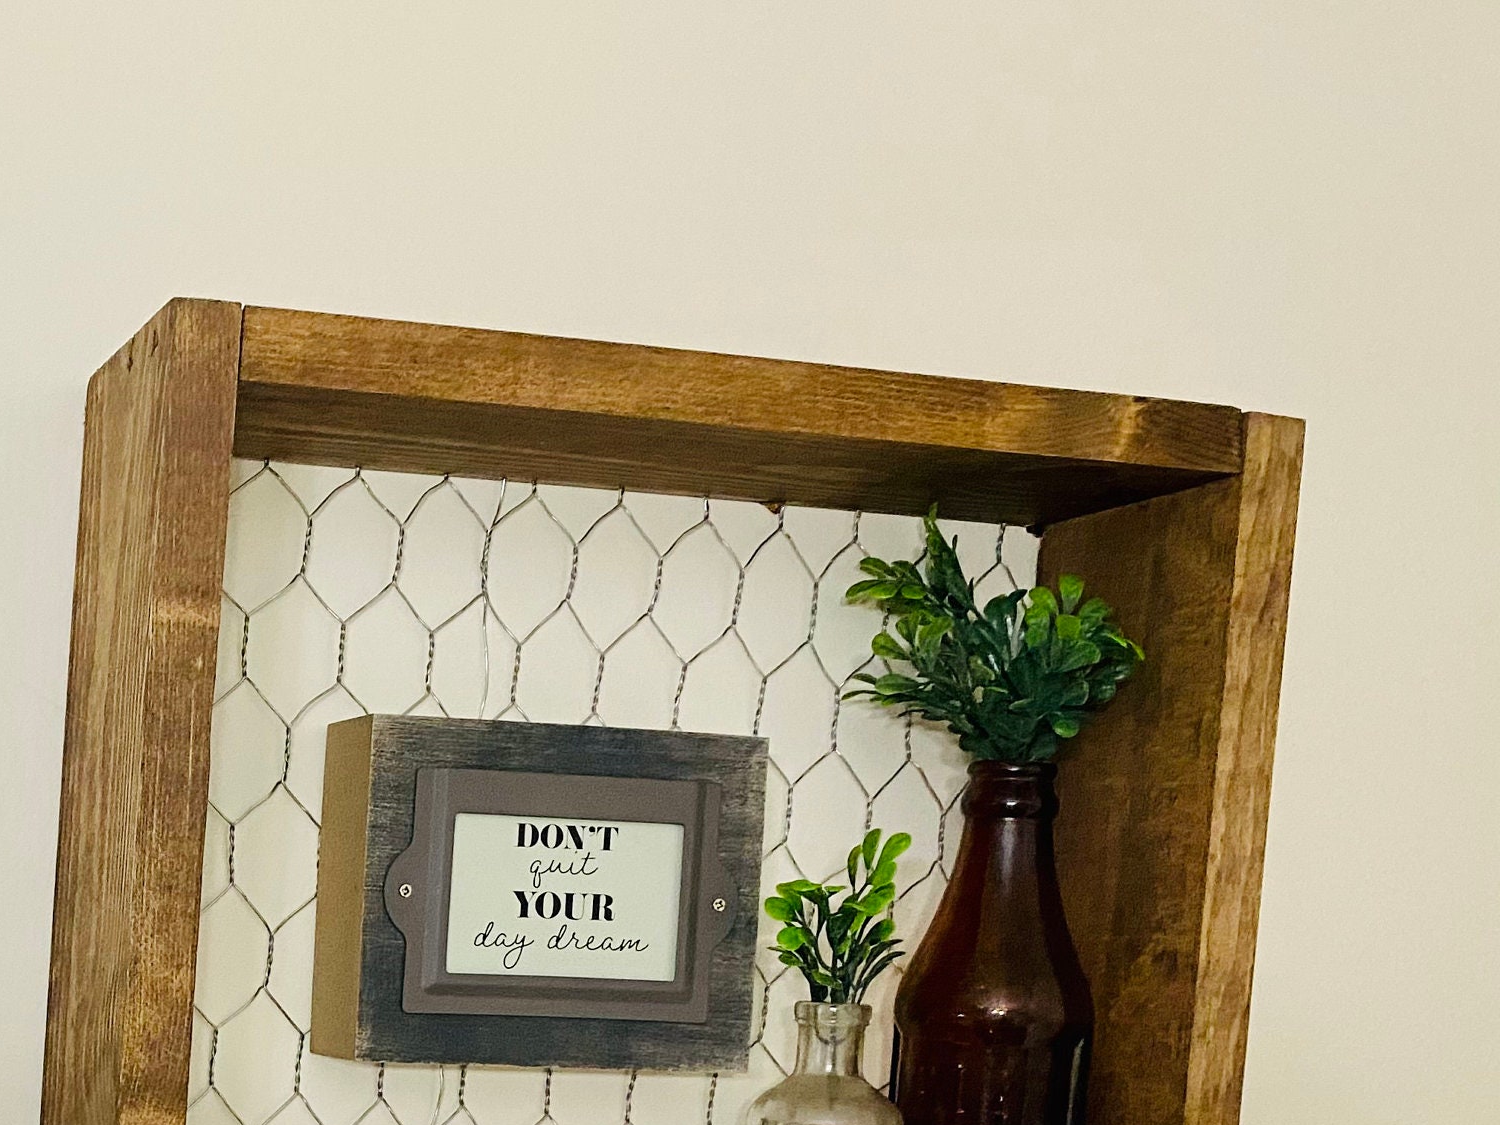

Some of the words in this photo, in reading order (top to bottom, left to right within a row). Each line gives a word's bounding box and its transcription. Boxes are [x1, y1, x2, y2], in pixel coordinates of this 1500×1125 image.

[516, 822, 619, 851] DON'T
[529, 851, 598, 888] quit
[513, 890, 615, 921] YOUR
[473, 921, 534, 969] day
[547, 924, 649, 952] dream
